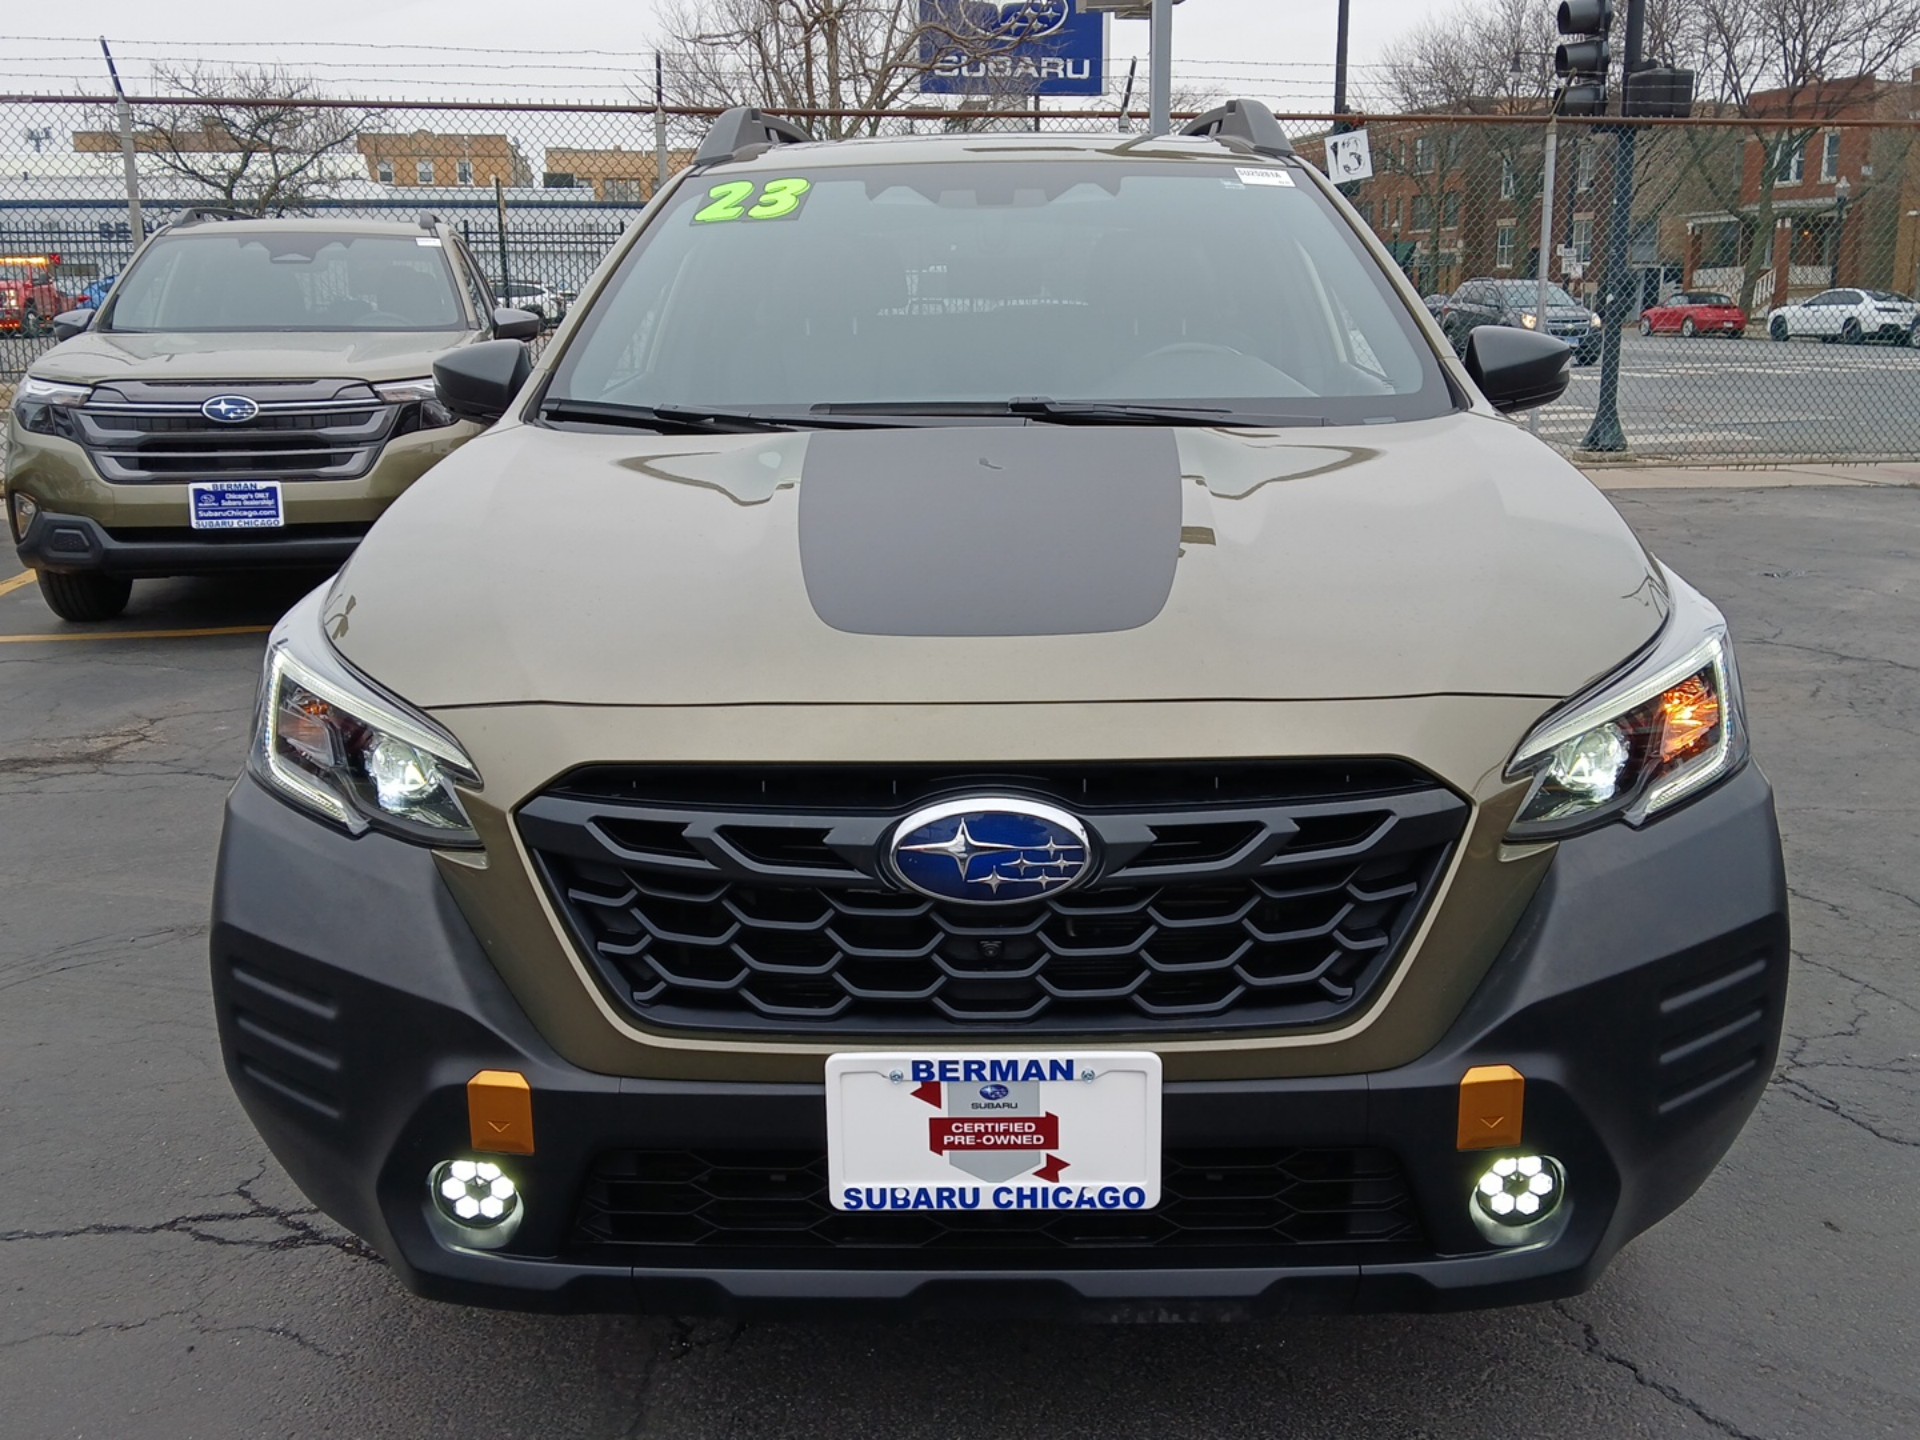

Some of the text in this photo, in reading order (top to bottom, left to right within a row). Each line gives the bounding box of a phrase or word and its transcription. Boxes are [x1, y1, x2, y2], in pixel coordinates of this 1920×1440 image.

[933, 56, 1091, 79] SUBARU
[1330, 136, 1365, 176] 13
[694, 177, 811, 223] 23
[212, 483, 257, 491] BERMAN
[198, 509, 276, 518] SubaruChicago.com
[196, 519, 280, 529] SUBARU CHICAGO
[911, 1059, 1075, 1082] BERMAN
[970, 1102, 1018, 1110] SUBARU
[951, 1121, 1036, 1134] CERTIFIED
[943, 1134, 1045, 1146] PRE-OWNED
[843, 1186, 1146, 1211] SUBARU CHICAGO
